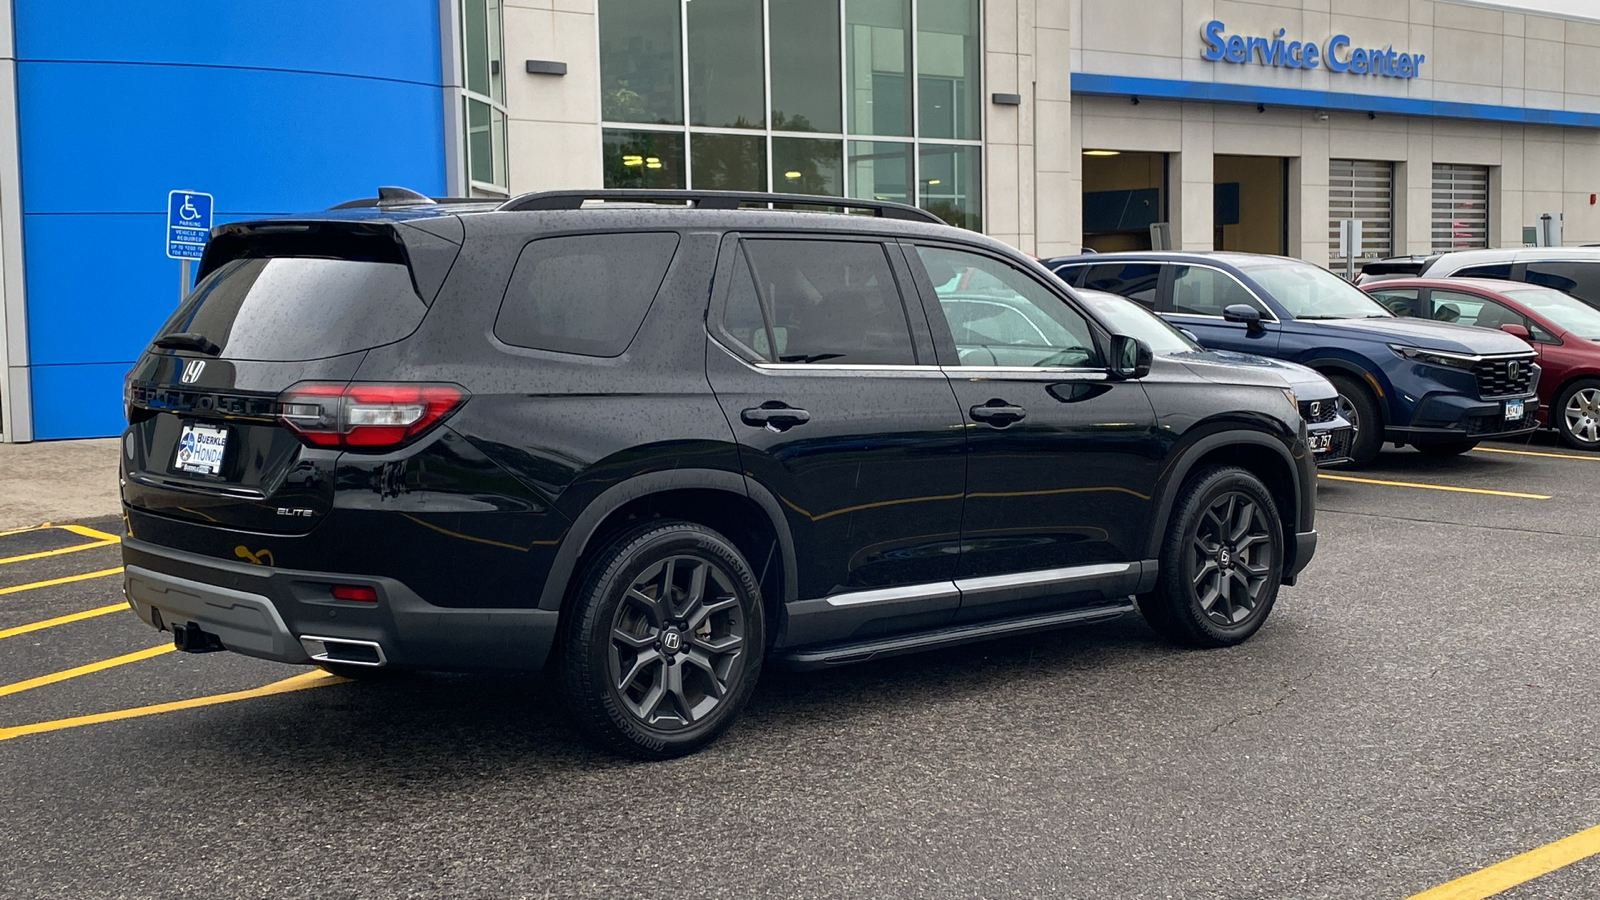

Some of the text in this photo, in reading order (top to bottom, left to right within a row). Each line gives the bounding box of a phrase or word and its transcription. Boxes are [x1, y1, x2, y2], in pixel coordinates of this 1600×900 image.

[1203, 20, 1425, 78] Service Center
[197, 433, 226, 446] BUERKLE
[1320, 434, 1332, 447] 757
[193, 444, 222, 462] HONDA
[276, 507, 313, 517] ELITE
[697, 539, 757, 598] BRIDGESTONE
[600, 690, 666, 752] BRIDGESTONE
